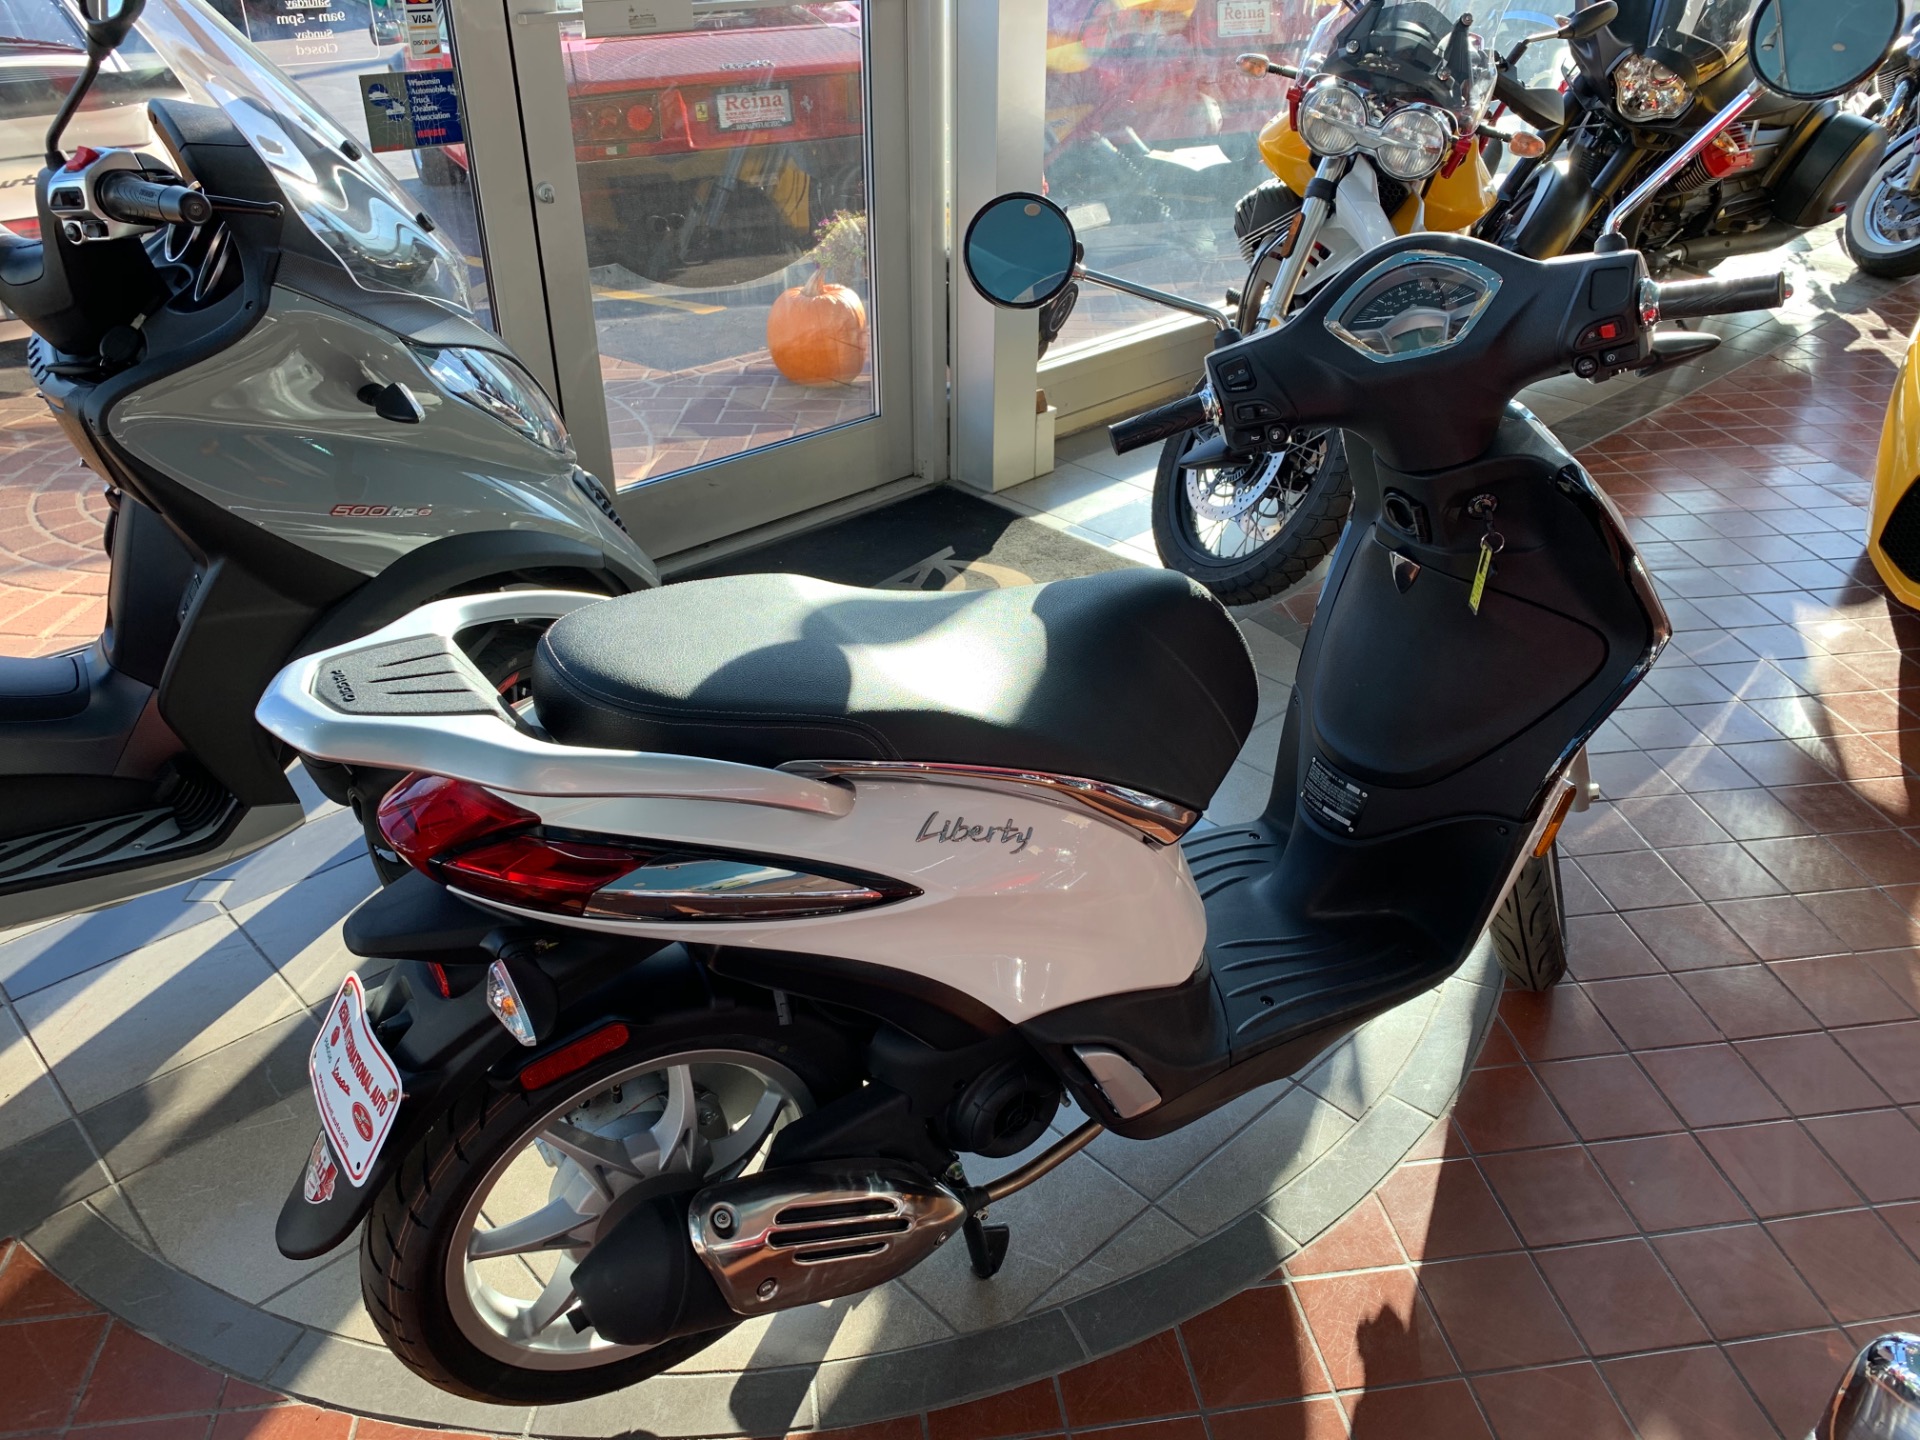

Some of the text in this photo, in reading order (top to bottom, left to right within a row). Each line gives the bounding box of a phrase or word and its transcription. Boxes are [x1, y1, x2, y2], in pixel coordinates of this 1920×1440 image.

[1224, 6, 1265, 19] Reina
[412, 14, 433, 24] VISA
[407, 77, 441, 87] Wisconsin
[411, 84, 446, 95] Automobile
[412, 95, 431, 104] Truck
[724, 92, 784, 112] Reina
[413, 104, 438, 113] Dealers
[415, 112, 451, 121] Association
[331, 669, 356, 703] PIAGGIO
[915, 810, 1033, 854] Liberty
[344, 1022, 374, 1095] INTERNATIONAL
[369, 1084, 388, 1117] AUTO
[331, 1056, 351, 1097] Vespa
